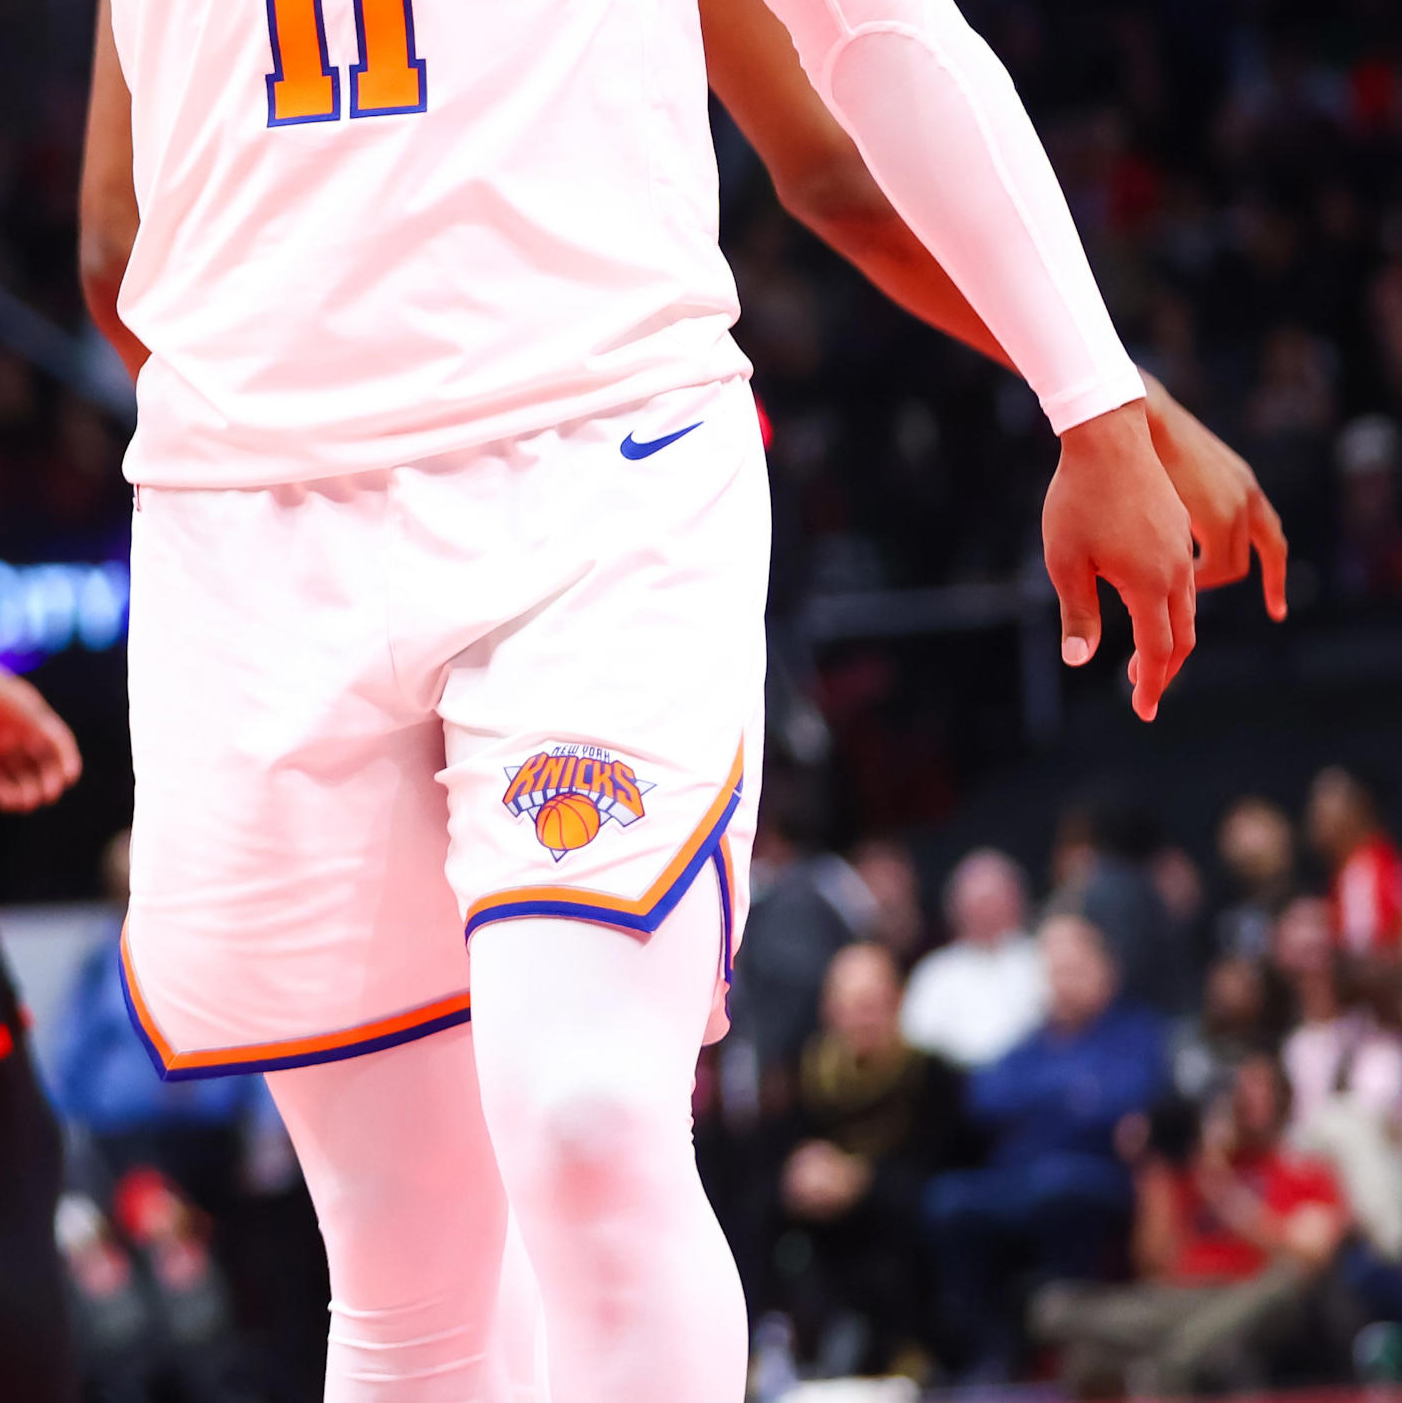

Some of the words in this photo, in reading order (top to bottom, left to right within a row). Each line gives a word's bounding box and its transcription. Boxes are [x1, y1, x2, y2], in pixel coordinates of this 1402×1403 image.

[551, 744, 580, 757] NEW
[582, 745, 611, 763] YORK
[502, 751, 646, 820] KNICKS
